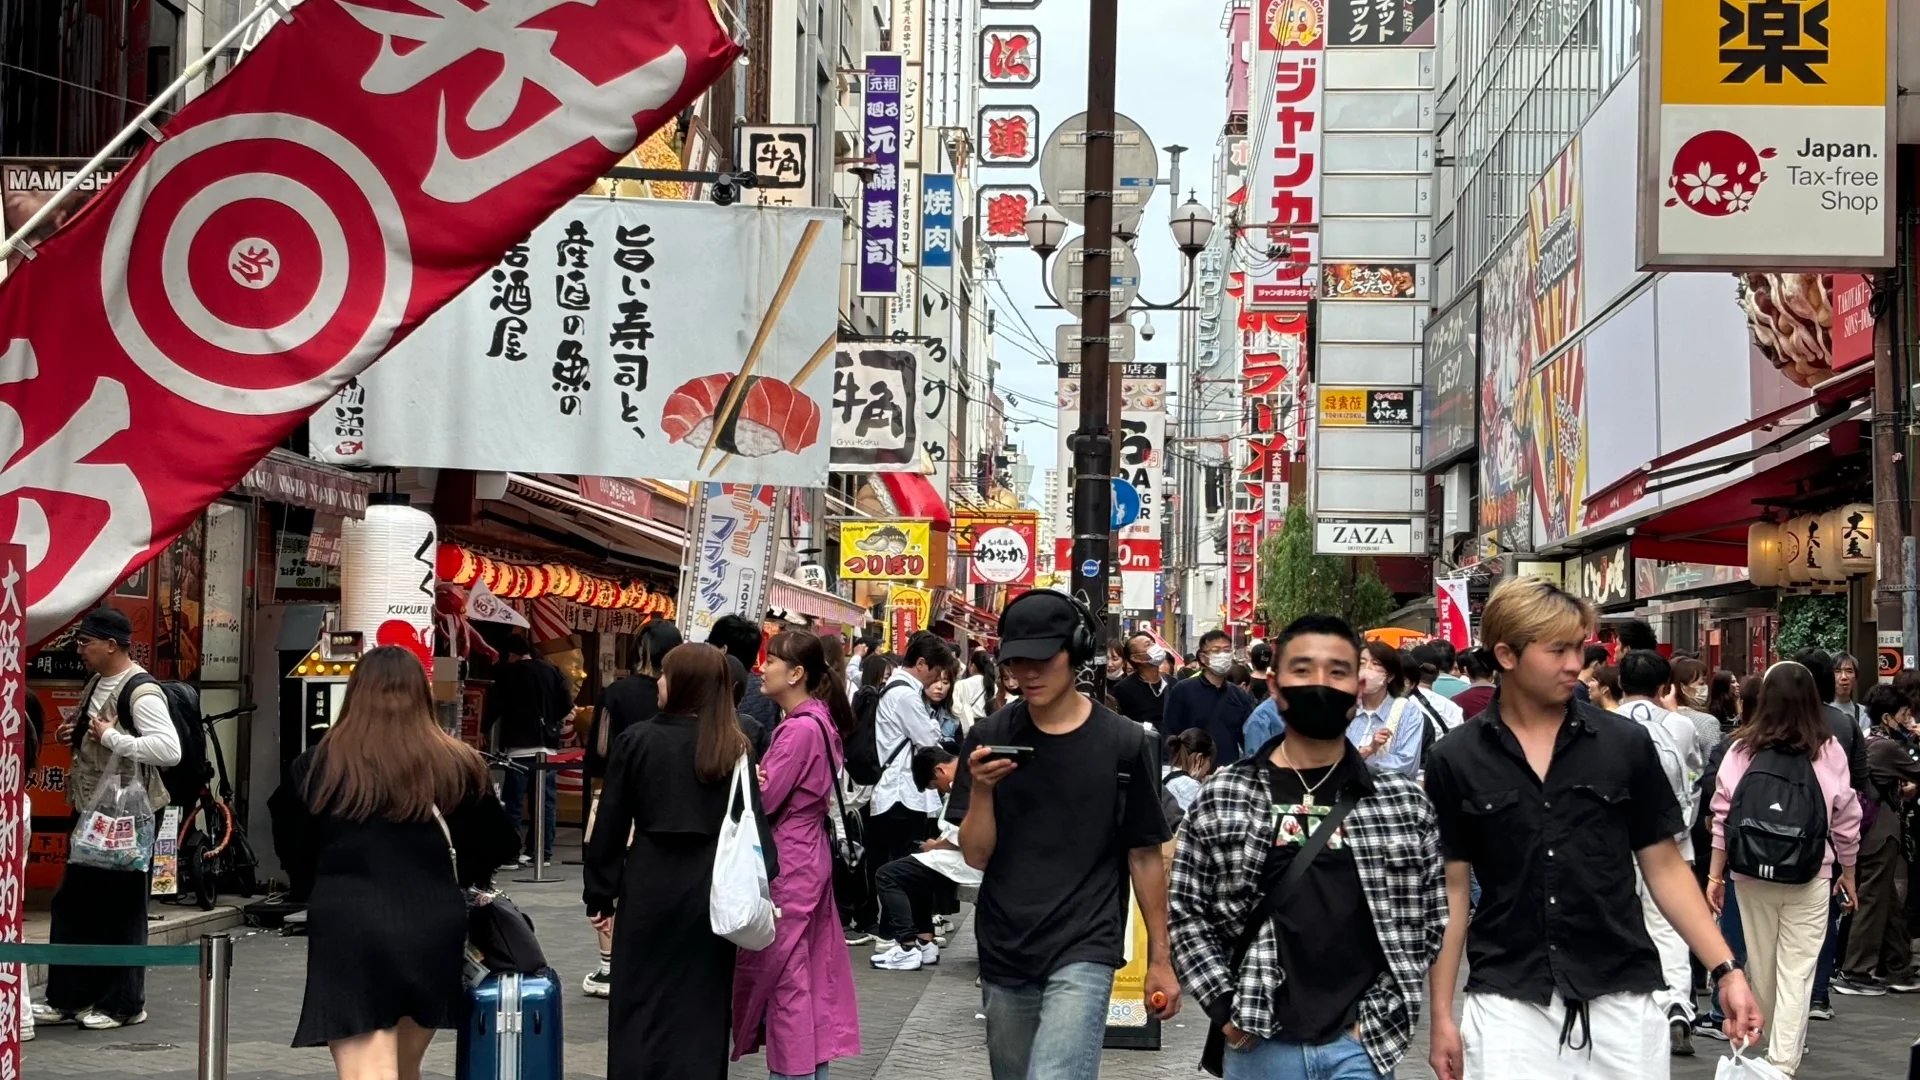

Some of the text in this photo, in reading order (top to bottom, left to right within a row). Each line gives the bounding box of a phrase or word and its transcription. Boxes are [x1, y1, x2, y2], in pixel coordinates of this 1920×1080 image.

[1349, 0, 1370, 42] ック
[1719, 0, 1829, 84] 楽
[1423, 65, 1431, 75] 6
[871, 77, 897, 91] 元祖
[866, 101, 899, 118] 廻る
[1422, 107, 1430, 117] 5
[1422, 149, 1429, 159] 4
[1797, 137, 1878, 160] Japan.
[757, 143, 801, 177] 牛角
[1271, 57, 1317, 281] ジャンカラ
[9, 171, 120, 190] MAMESH
[1786, 166, 1879, 187] Tax-free
[866, 125, 899, 269] 元禄寿司
[1420, 191, 1428, 202] 3
[1820, 191, 1879, 214] Shop
[924, 188, 953, 252] 焼肉
[1419, 234, 1427, 244] 3
[1419, 276, 1427, 287] 3
[1838, 281, 1871, 315] TAKOYAKI-
[552, 220, 595, 416] 産直の魚の
[1418, 318, 1426, 329] 3
[609, 223, 655, 439] 旨い寿司と、
[833, 371, 905, 439] 牛角
[837, 438, 880, 448] Gyu-Kaku
[1414, 488, 1424, 498] B1
[843, 524, 864, 532] Fishing
[1333, 527, 1394, 544] ZAZA
[1414, 531, 1423, 540] B1
[975, 543, 1024, 563] わなか
[700, 514, 738, 615] フライング
[844, 555, 924, 576] つりぼり
[387, 604, 428, 615] KUKURU
[1441, 597, 1451, 619] Tax
